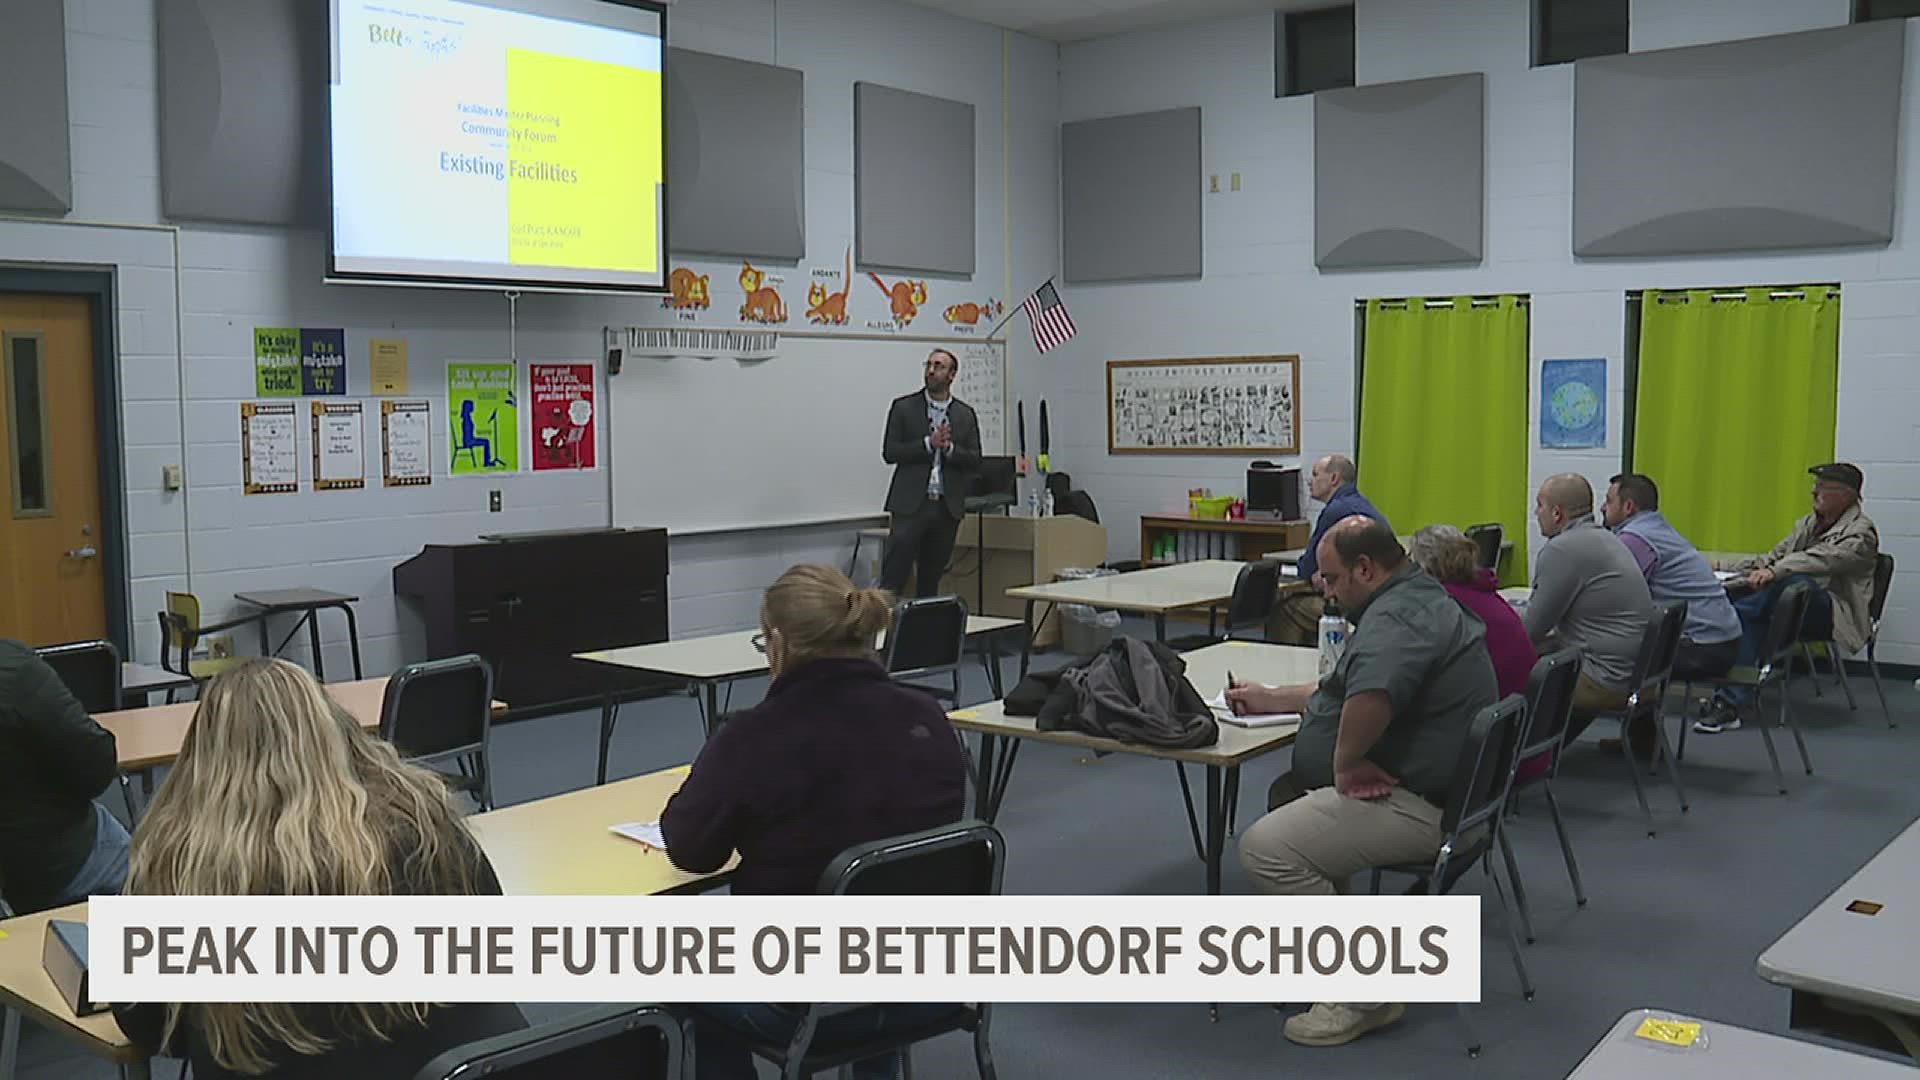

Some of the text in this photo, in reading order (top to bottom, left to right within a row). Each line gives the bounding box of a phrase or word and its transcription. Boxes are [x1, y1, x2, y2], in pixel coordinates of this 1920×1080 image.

[524, 128, 557, 143] Forum
[439, 151, 578, 184] Existing Facilities
[303, 352, 343, 368] mistake
